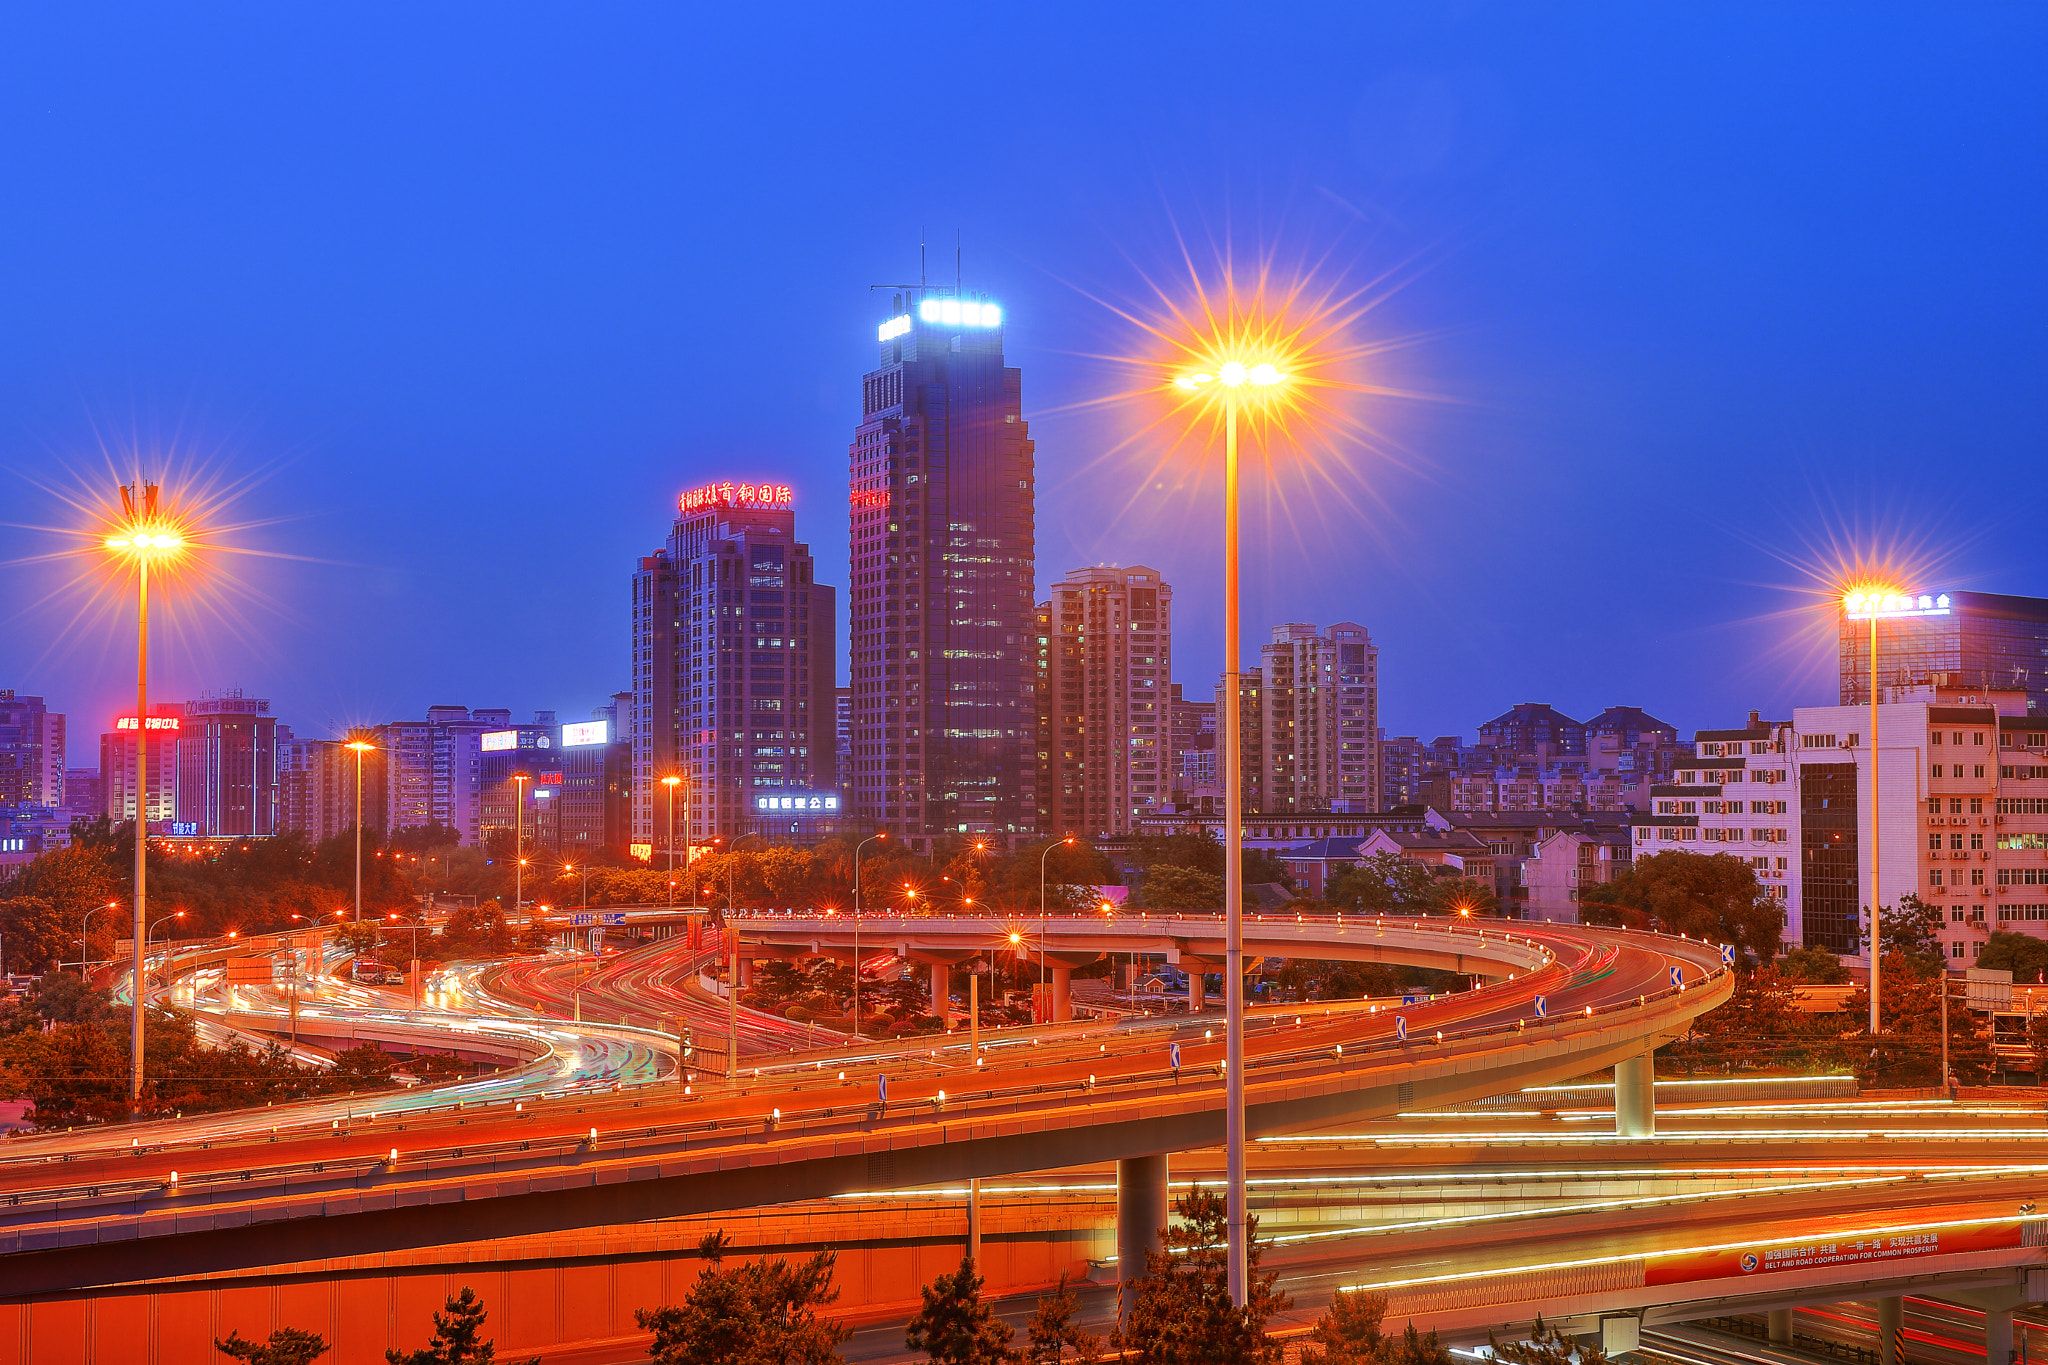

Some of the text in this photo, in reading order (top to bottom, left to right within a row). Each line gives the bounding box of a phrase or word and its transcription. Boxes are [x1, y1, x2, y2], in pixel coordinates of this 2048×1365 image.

[718, 482, 792, 502] 首钢国际
[221, 700, 269, 712] 中国节能
[1764, 1246, 1817, 1261] 加强国际合作
[1820, 1243, 1837, 1255] 共建
[1889, 1233, 1938, 1247] 实现共赢发展
[1764, 1245, 1939, 1270] BELT AND ROAD COOPERATION FOR COMMON PROSPERITY
